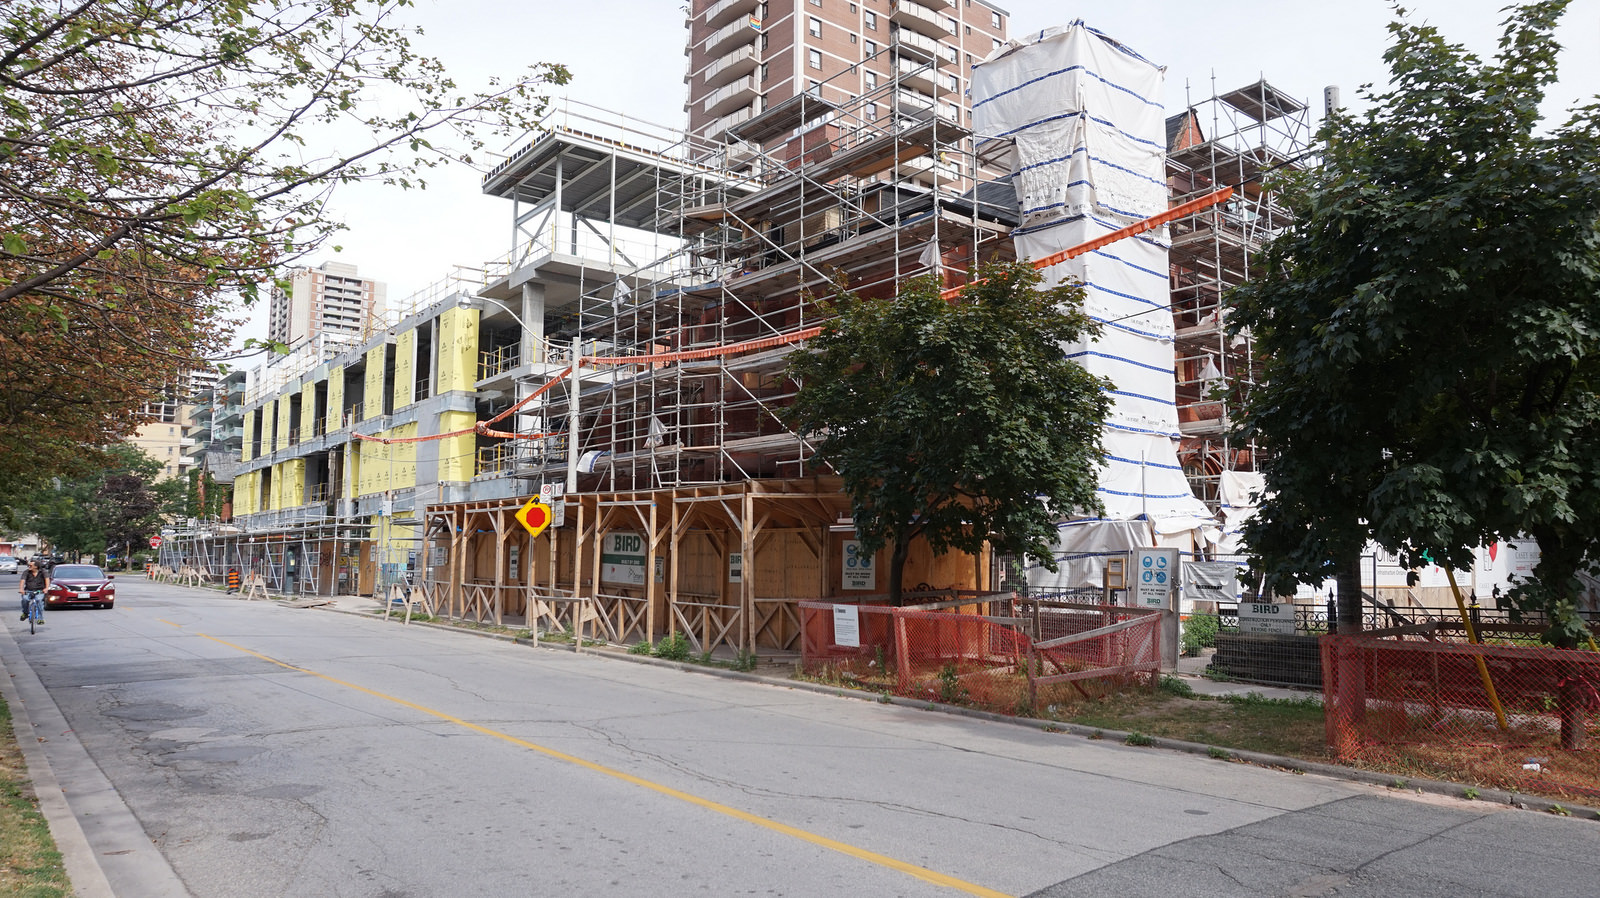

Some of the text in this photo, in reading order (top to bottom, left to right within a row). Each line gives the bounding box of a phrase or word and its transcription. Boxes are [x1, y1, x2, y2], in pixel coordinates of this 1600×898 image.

[614, 535, 641, 552] BIRD
[730, 555, 741, 564] BIR
[1252, 604, 1280, 614] BIRD
